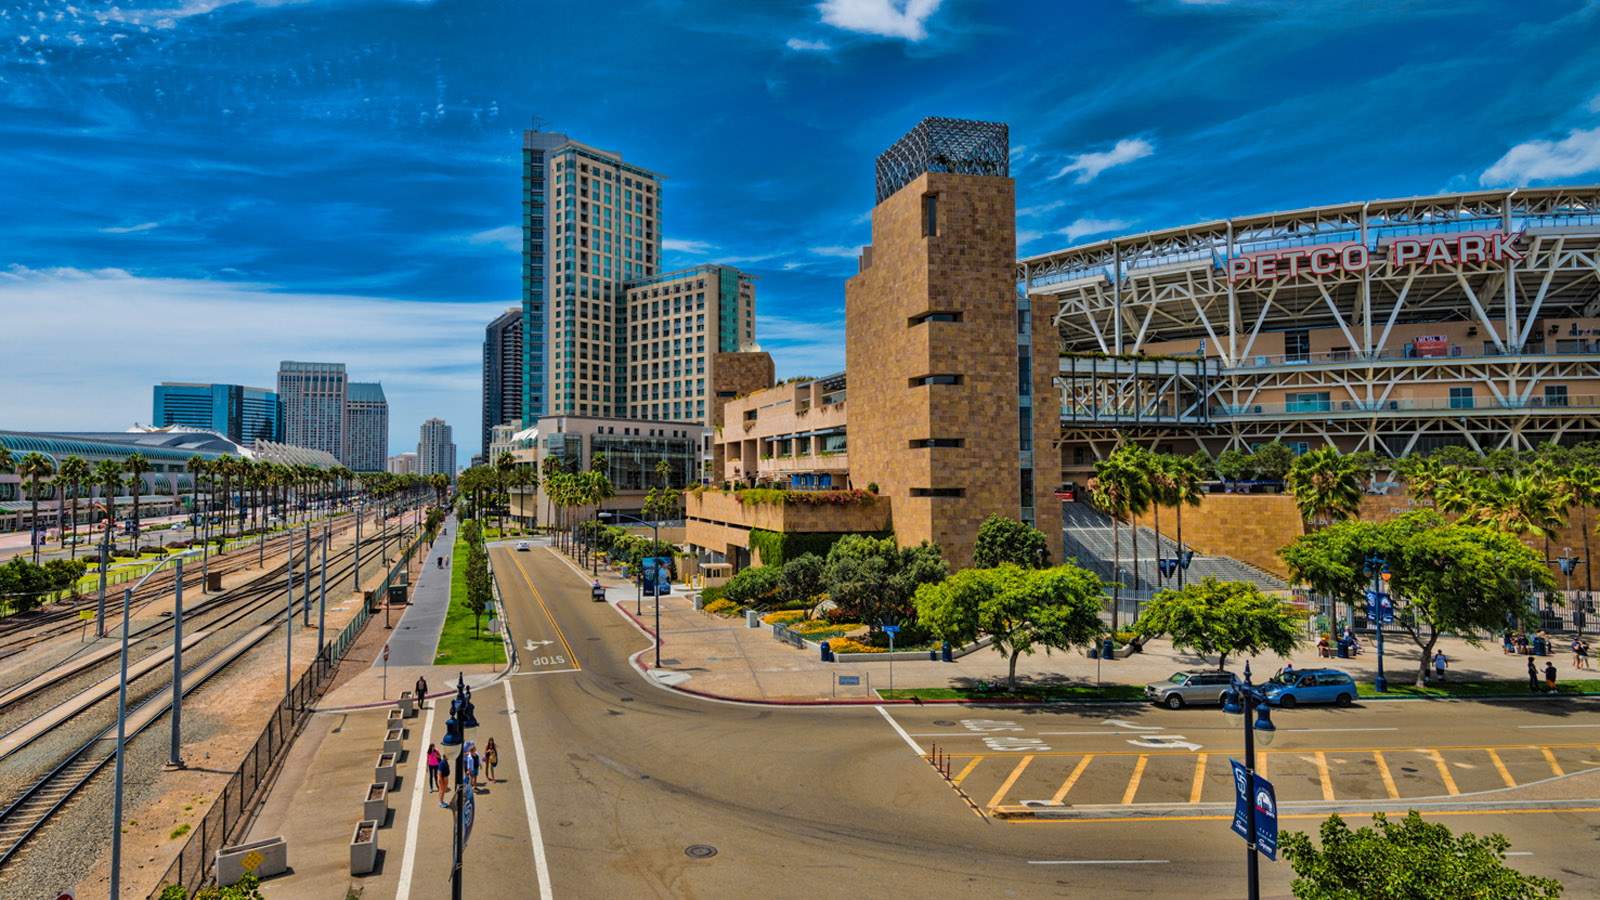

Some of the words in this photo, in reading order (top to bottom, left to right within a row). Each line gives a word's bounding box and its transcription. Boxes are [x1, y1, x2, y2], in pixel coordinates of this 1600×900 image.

[1228, 244, 1369, 284] PETCO
[1394, 232, 1525, 268] PARK
[532, 655, 565, 666] STOP
